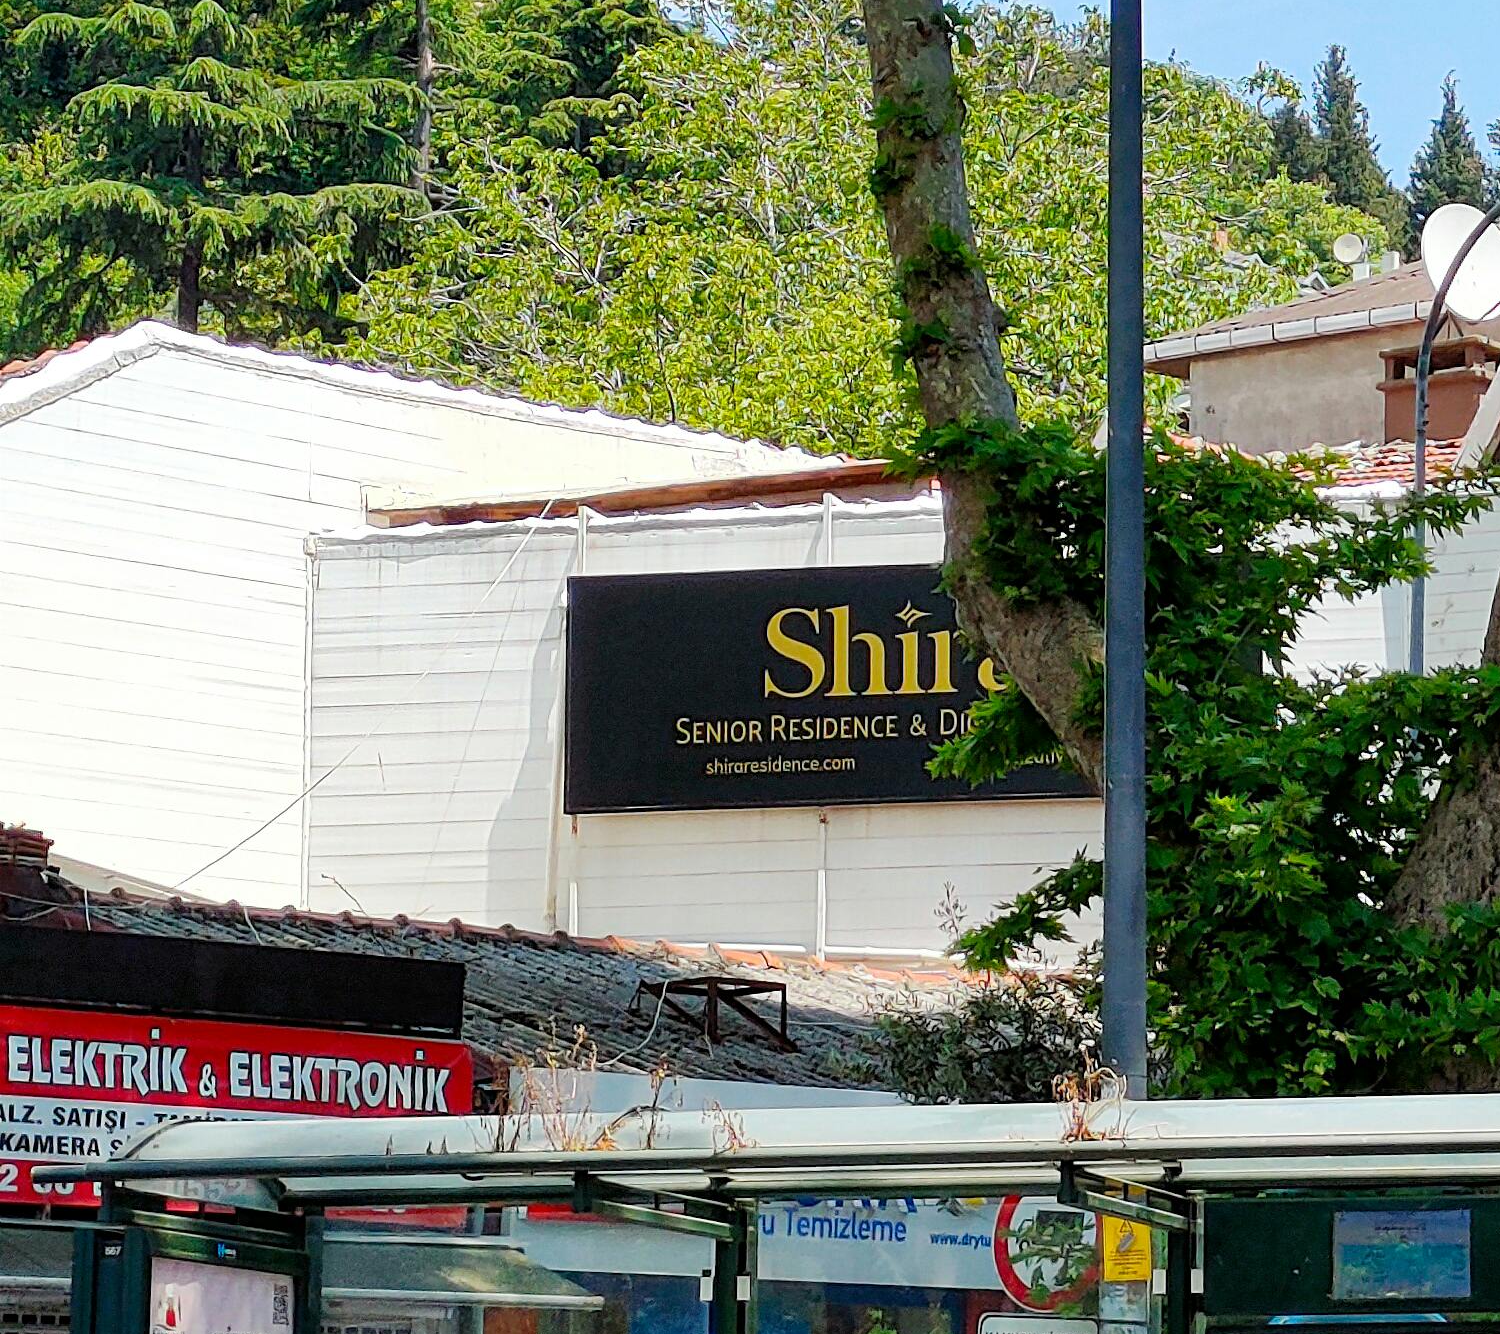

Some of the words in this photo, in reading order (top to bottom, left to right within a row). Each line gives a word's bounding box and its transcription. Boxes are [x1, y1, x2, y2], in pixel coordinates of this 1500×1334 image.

[909, 713, 927, 737] &
[705, 755, 856, 776] shiraresidence.com
[8, 1027, 189, 1097] ELEKTRİK
[199, 1063, 217, 1099] &
[230, 1049, 450, 1114] ELEKTRONİK
[52, 1106, 126, 1135] SATIŞI
[0, 1132, 101, 1157] KAMERA
[782, 1207, 908, 1242] Temizleme
